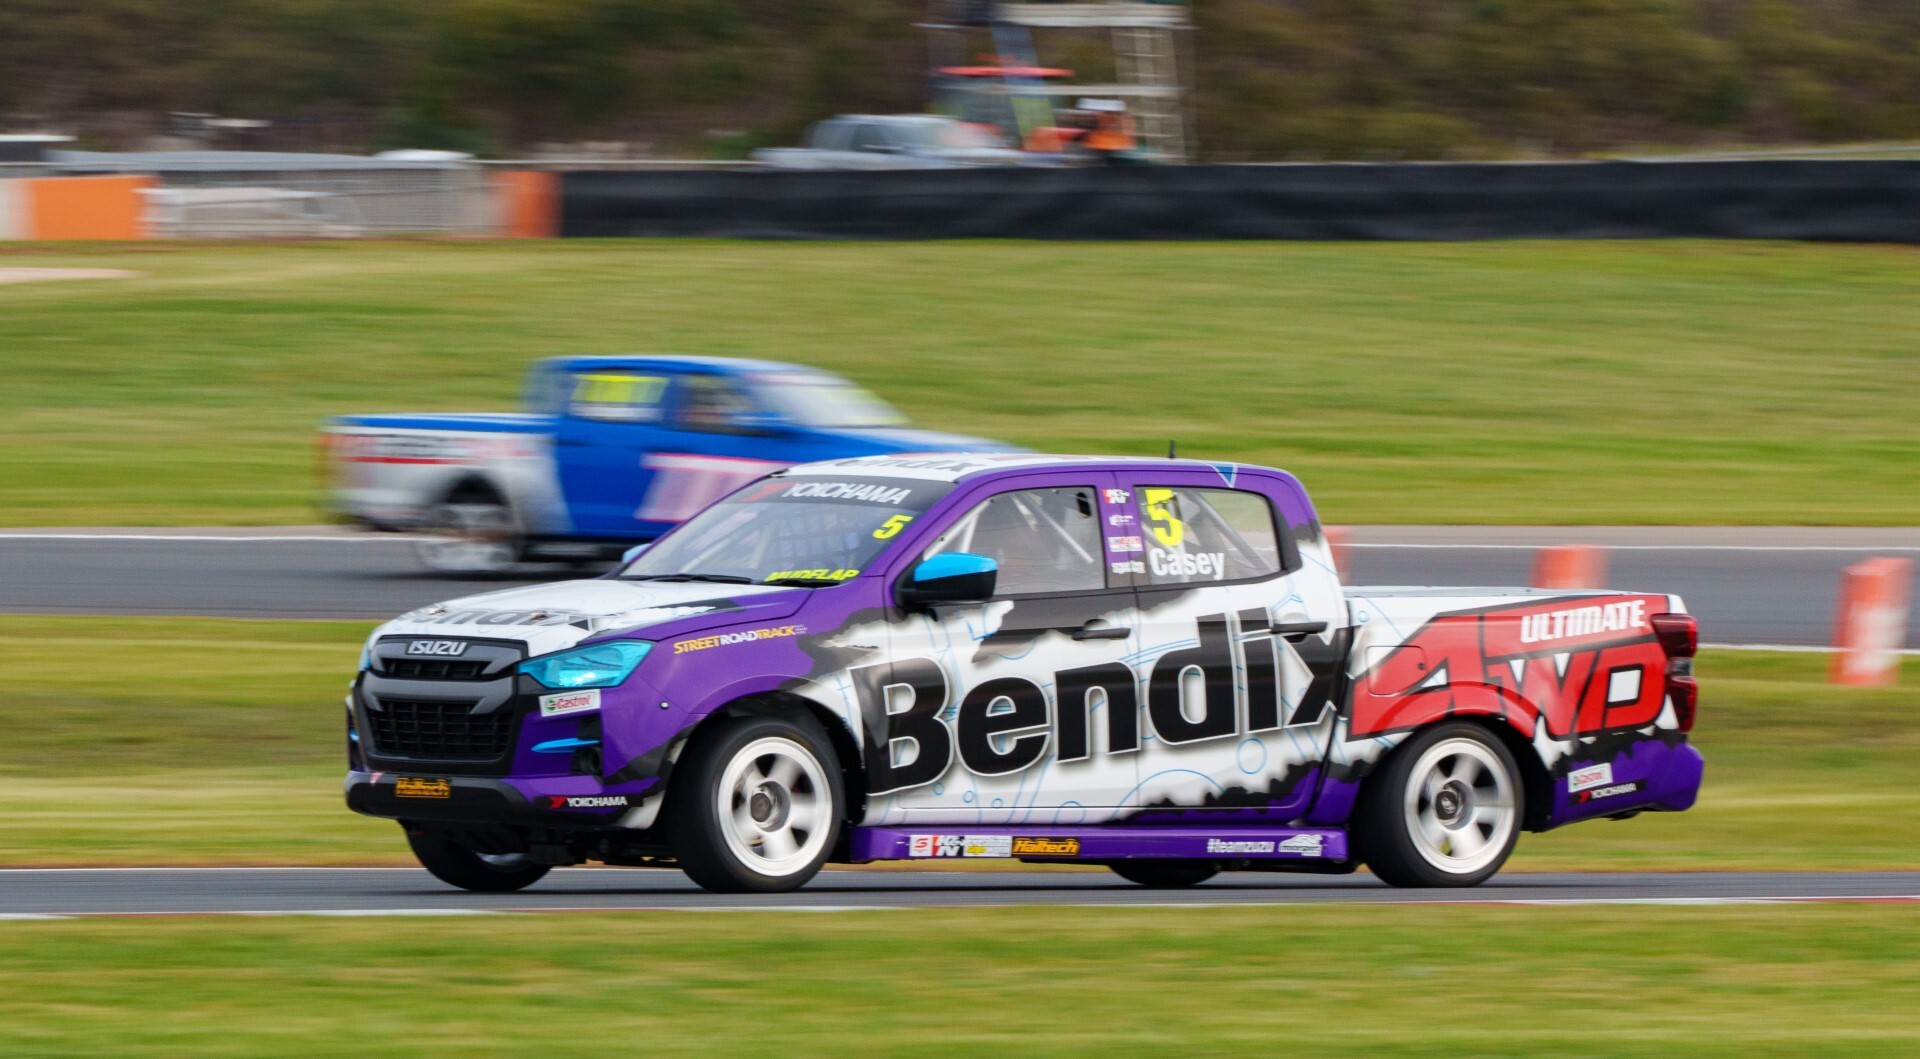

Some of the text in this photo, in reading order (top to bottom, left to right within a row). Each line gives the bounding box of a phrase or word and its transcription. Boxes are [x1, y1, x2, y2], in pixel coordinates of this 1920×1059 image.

[782, 482, 912, 505] YOKOHAMA
[872, 514, 914, 539] 5
[1144, 489, 1183, 546] 5
[763, 568, 860, 582] MUDFLAP
[1151, 548, 1224, 581] Casey
[1520, 599, 1646, 643] ULTIMATE
[407, 640, 468, 656] ISUZU
[1351, 613, 1668, 743] 4WD
[556, 695, 592, 710] Castrol
[847, 606, 1360, 796] Bendix
[566, 796, 628, 807] YOKOHAMA
[1012, 837, 1081, 855] Haltech
